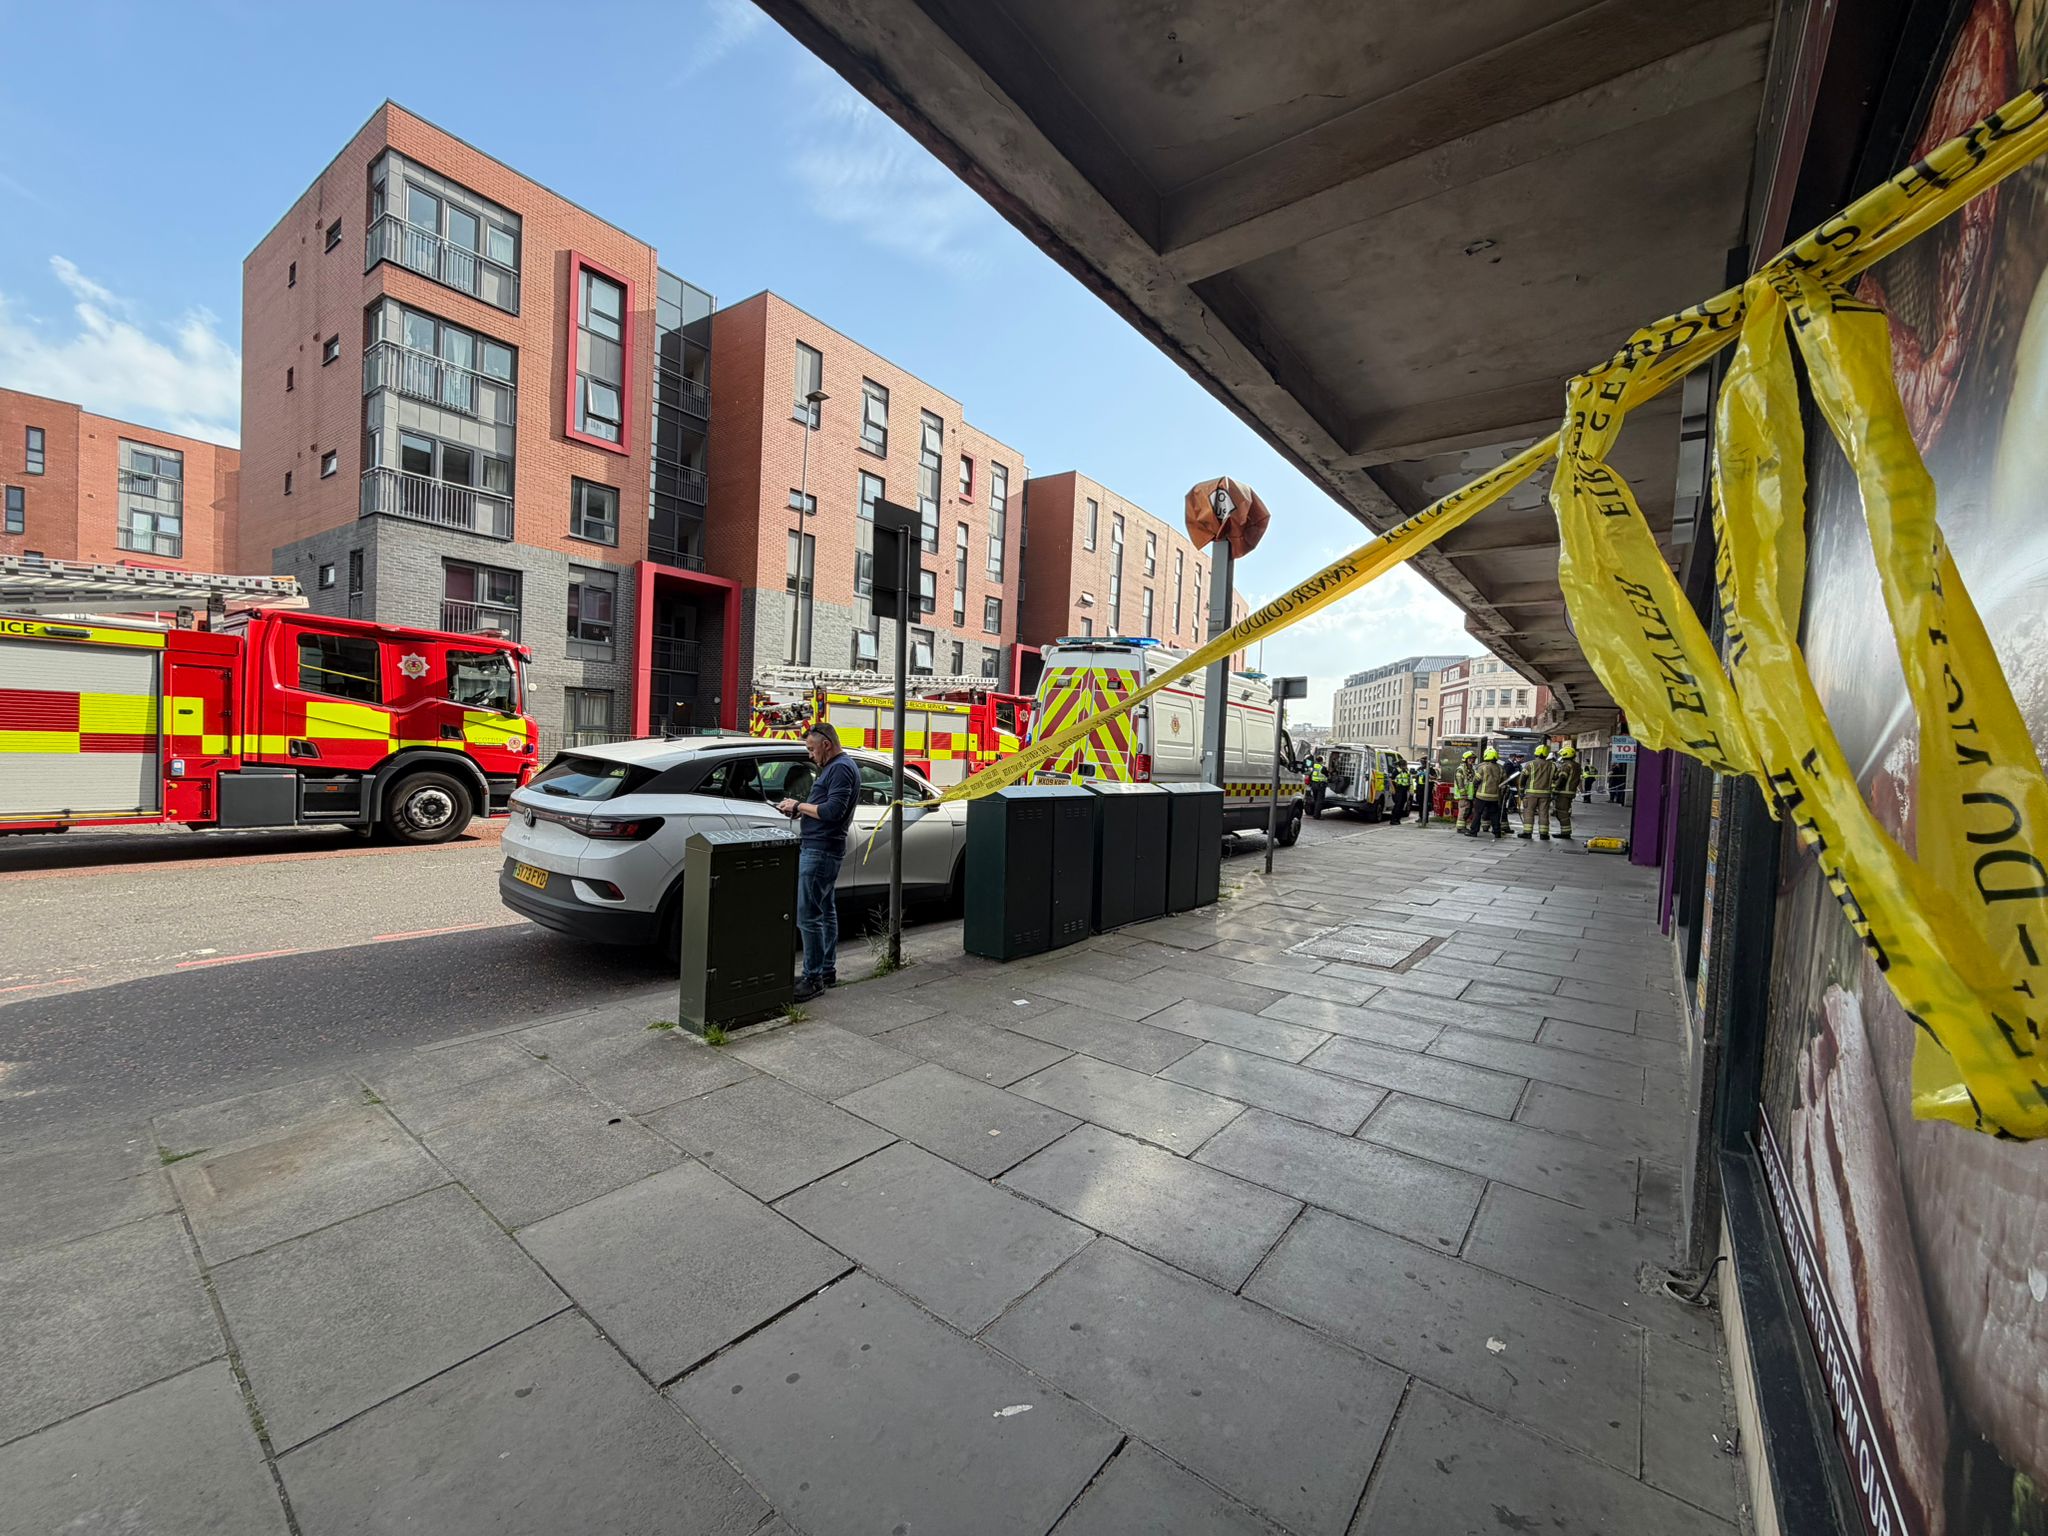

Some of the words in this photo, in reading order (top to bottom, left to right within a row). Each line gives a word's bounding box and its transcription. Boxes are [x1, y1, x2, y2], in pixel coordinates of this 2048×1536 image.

[0, 621, 35, 634] ICE
[862, 697, 887, 706] SCOTTISH
[1616, 745, 1631, 753] TO
[516, 862, 532, 881] SY73
[531, 868, 547, 887] FYD
[1798, 1246, 1827, 1352] MEATS
[1826, 1336, 1859, 1457] FROM
[1859, 1439, 1891, 1536] OUR
